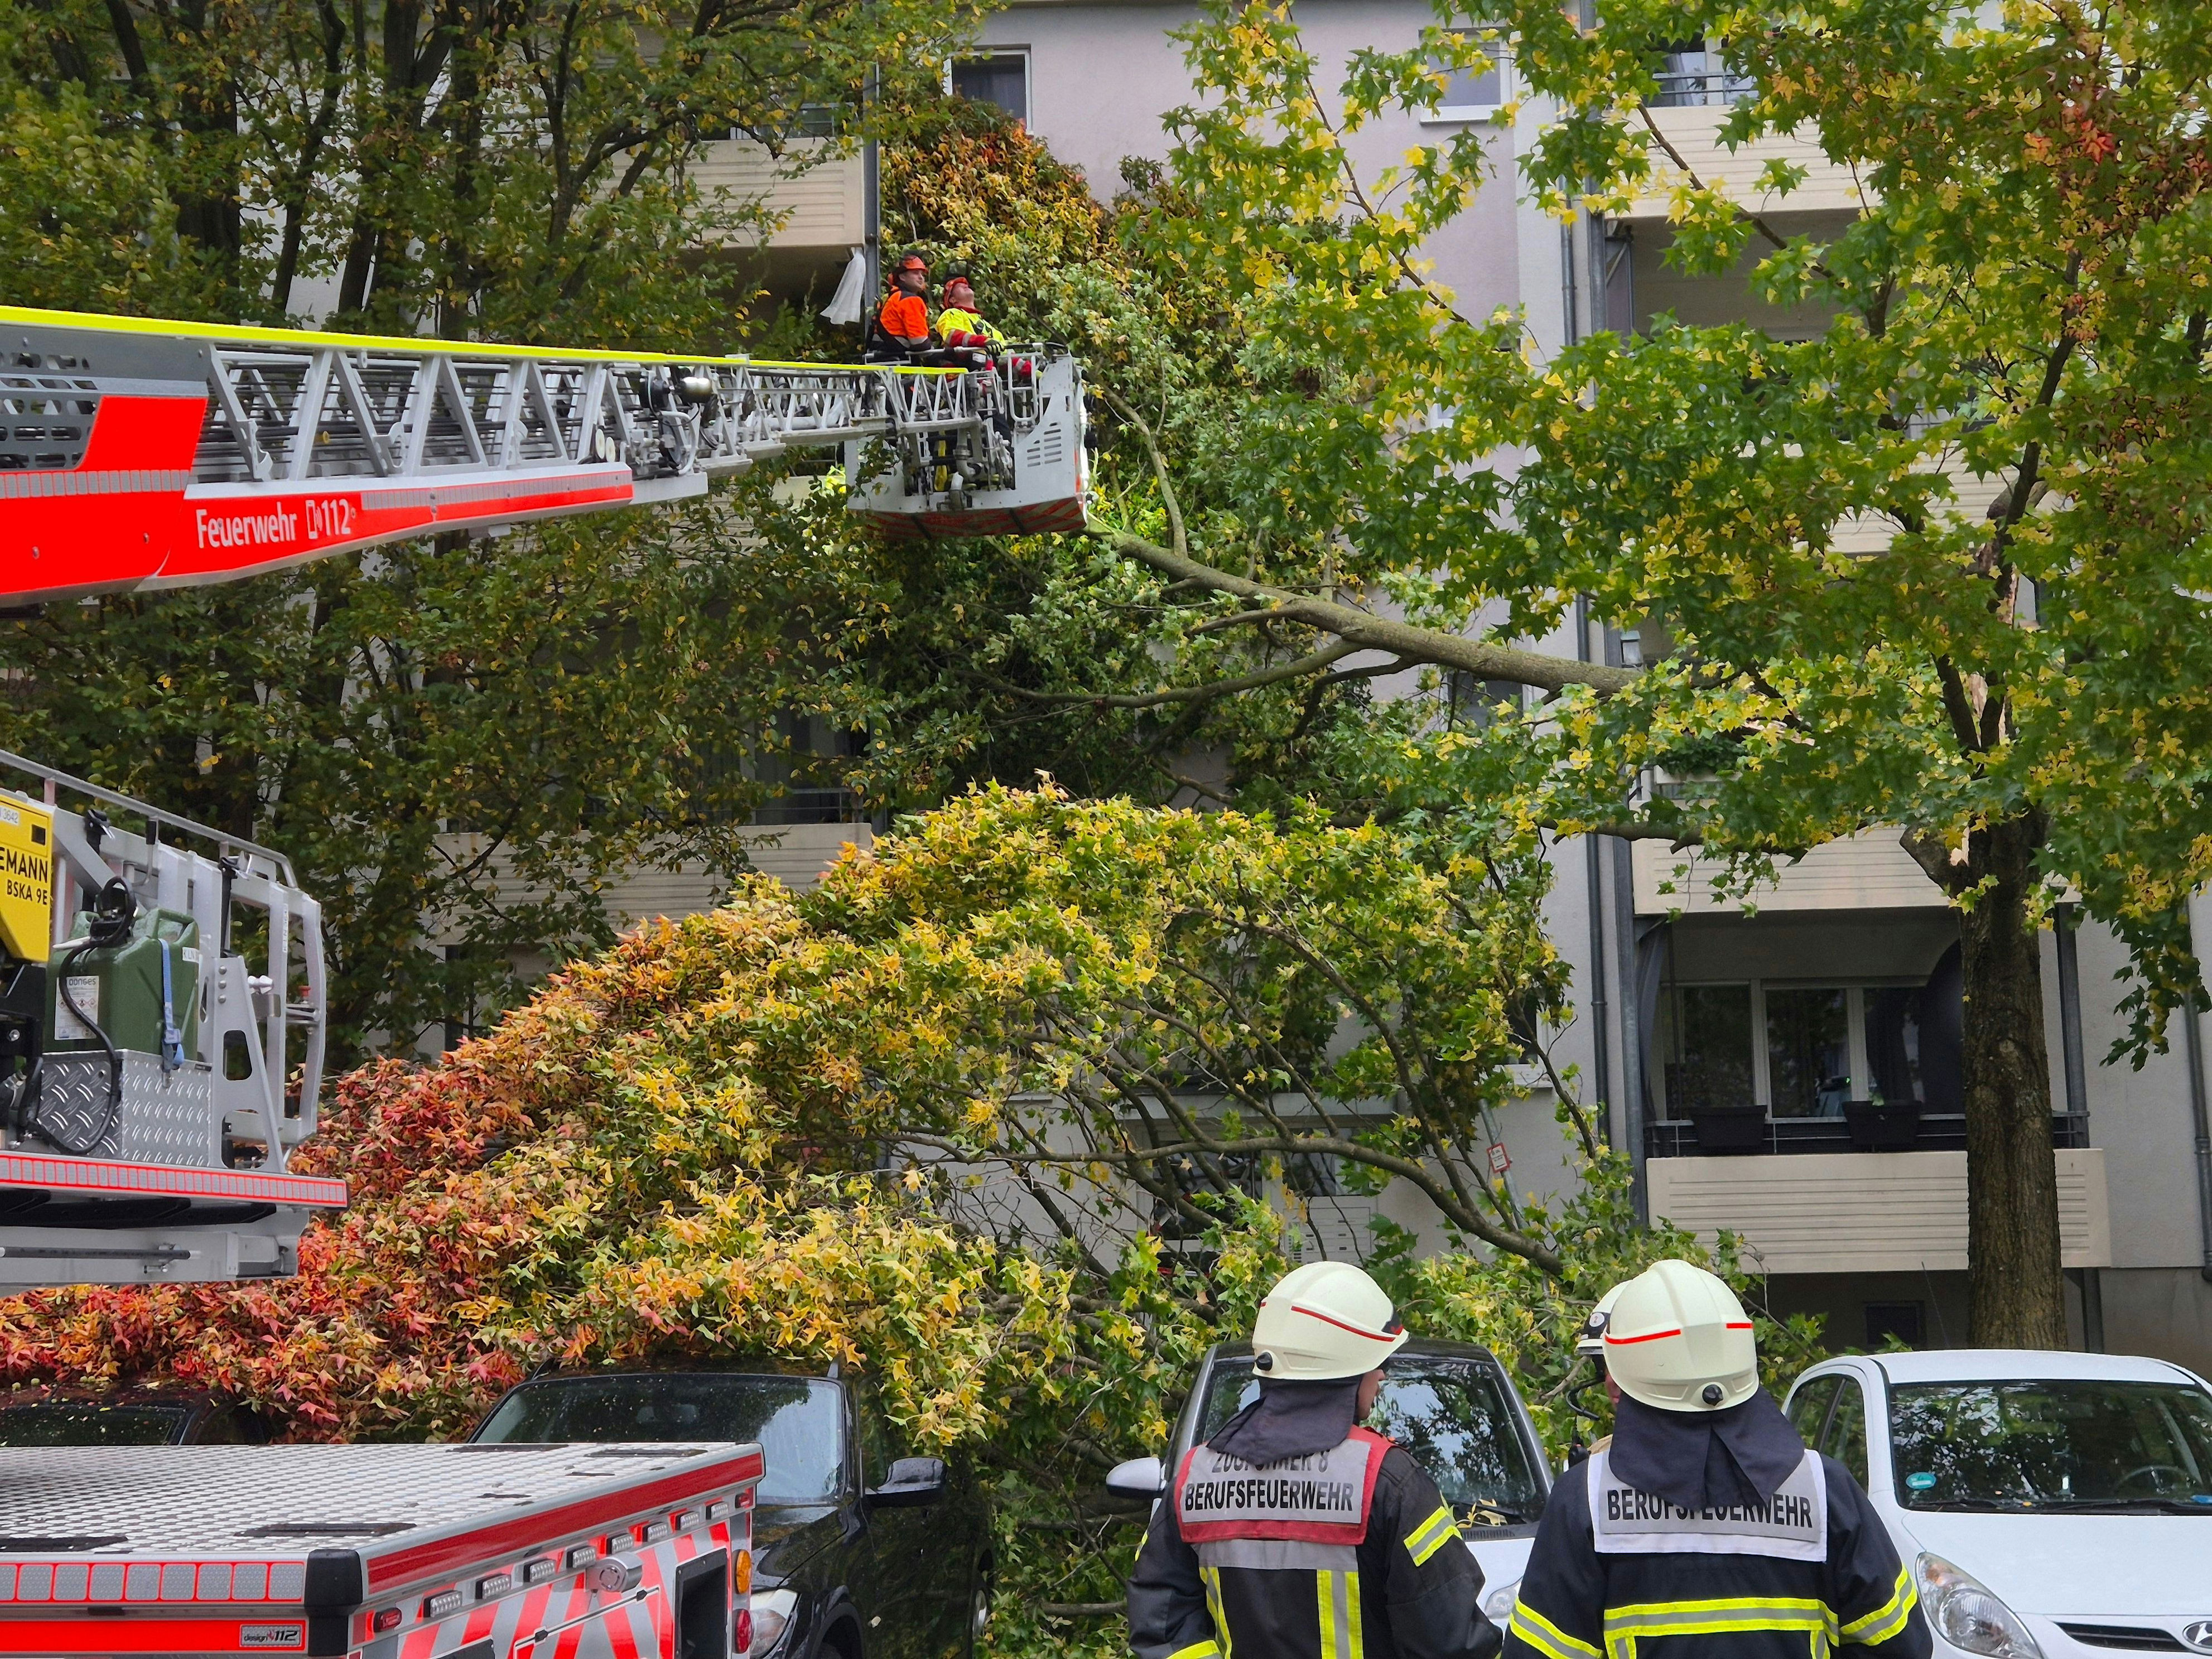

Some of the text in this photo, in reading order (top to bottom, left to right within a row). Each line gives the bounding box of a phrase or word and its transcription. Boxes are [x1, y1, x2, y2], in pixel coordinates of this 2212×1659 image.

[196, 499, 351, 549] Feuerwehr 112
[3, 808, 18, 824] 3642
[7, 879, 48, 905] BSKA 9E
[1185, 1479, 1354, 1511] BERUFSFEUERWEHR
[244, 1630, 298, 1642] design 112
